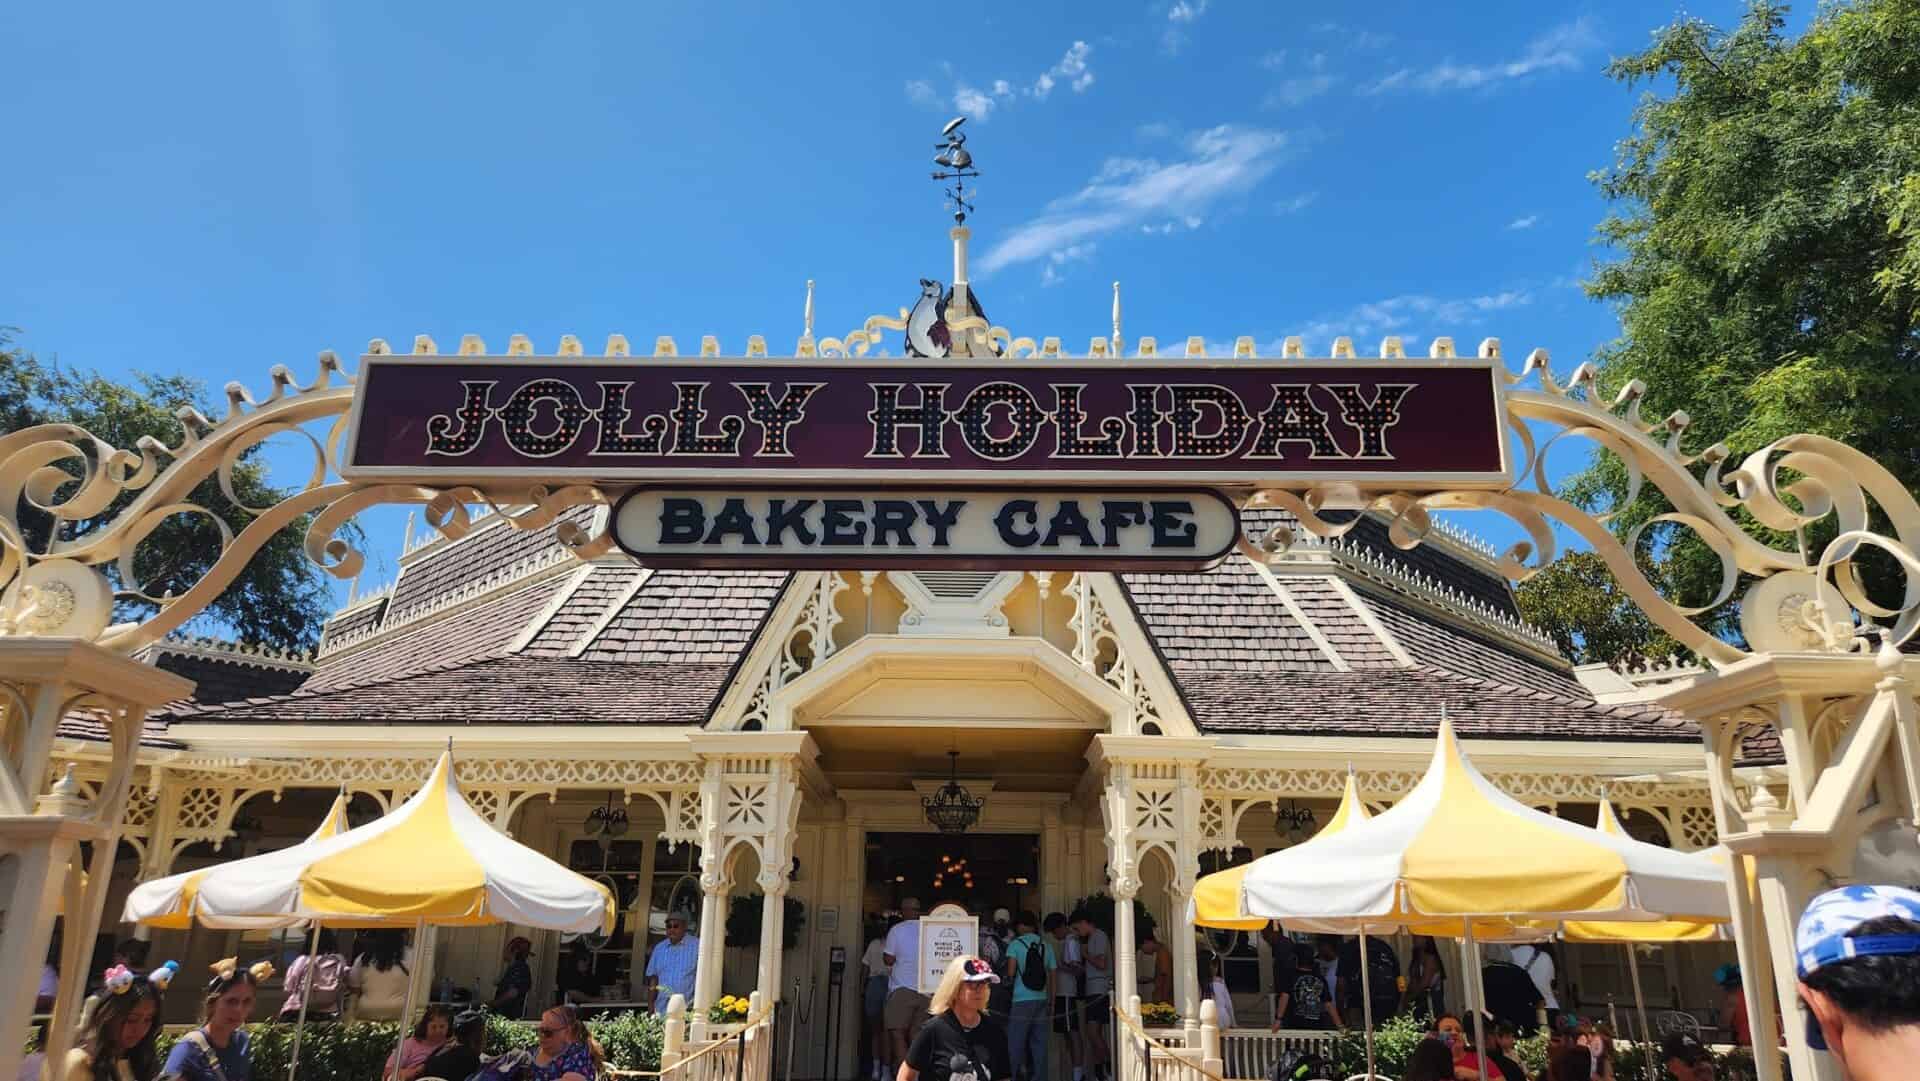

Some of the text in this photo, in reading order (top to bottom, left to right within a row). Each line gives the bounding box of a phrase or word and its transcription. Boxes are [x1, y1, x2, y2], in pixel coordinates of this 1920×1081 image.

[425, 379, 1419, 460] JOLLY HOLIDAY
[658, 499, 1197, 547] BAKERY CAFE
